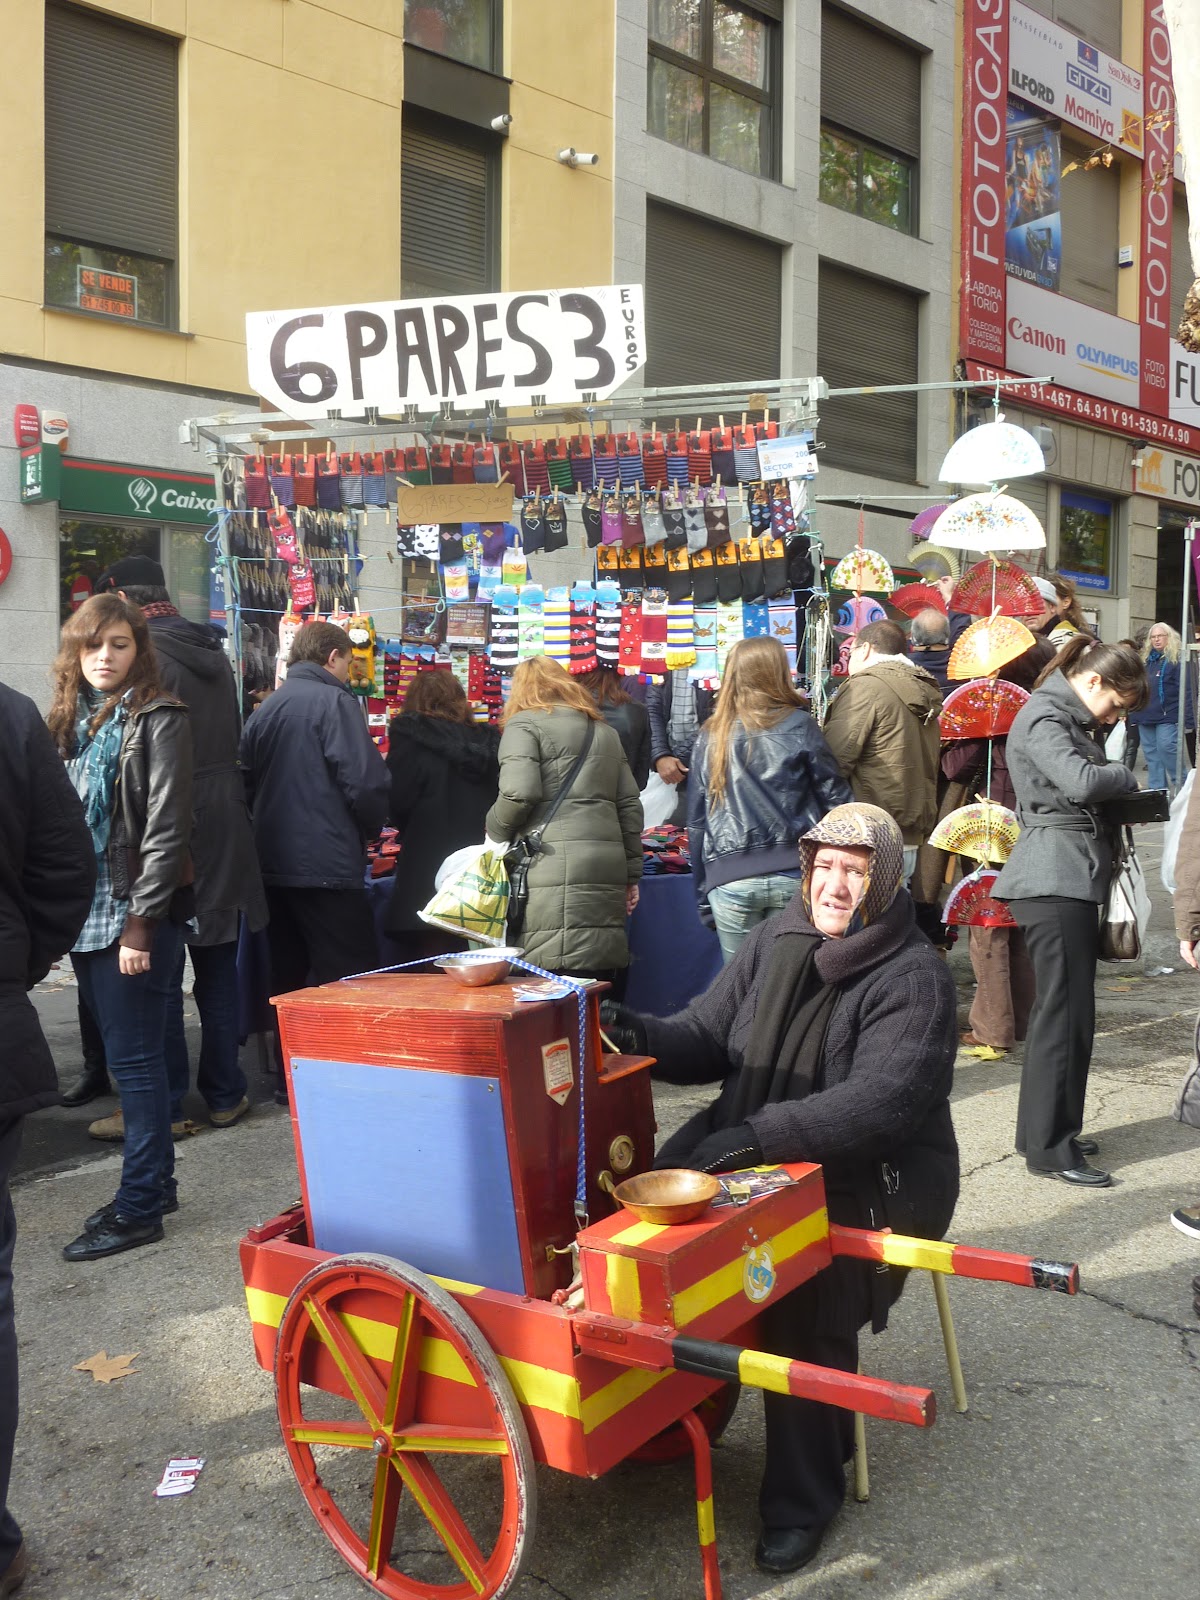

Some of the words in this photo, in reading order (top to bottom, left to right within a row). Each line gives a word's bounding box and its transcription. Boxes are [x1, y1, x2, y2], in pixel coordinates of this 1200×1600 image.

[1012, 15, 1063, 50] HASSELBLAD
[1011, 68, 1055, 105] ILFORD
[1068, 65, 1110, 103] GITZO
[1064, 94, 1114, 137] Mamiya
[82, 270, 96, 286] SE
[99, 273, 132, 294] VENDE
[972, 294, 998, 313] TORIO
[969, 317, 1002, 335] COLECCION
[974, 329, 1002, 344] MATERIAL
[1008, 317, 1066, 356] Canon
[269, 313, 338, 404] 6
[344, 295, 553, 400] PARES
[559, 293, 616, 390] 3
[968, 336, 977, 346] DE
[977, 339, 1003, 354] OCASION
[1076, 343, 1139, 377] OLYMPUS
[1145, 358, 1165, 375] FOTO
[1144, 371, 1166, 389] VIDEO
[1030, 383, 1108, 421] 91-467.64.91
[1111, 408, 1119, 424] Y
[1121, 411, 1190, 444] 91-539.74.90
[763, 462, 793, 473] SECTOR
